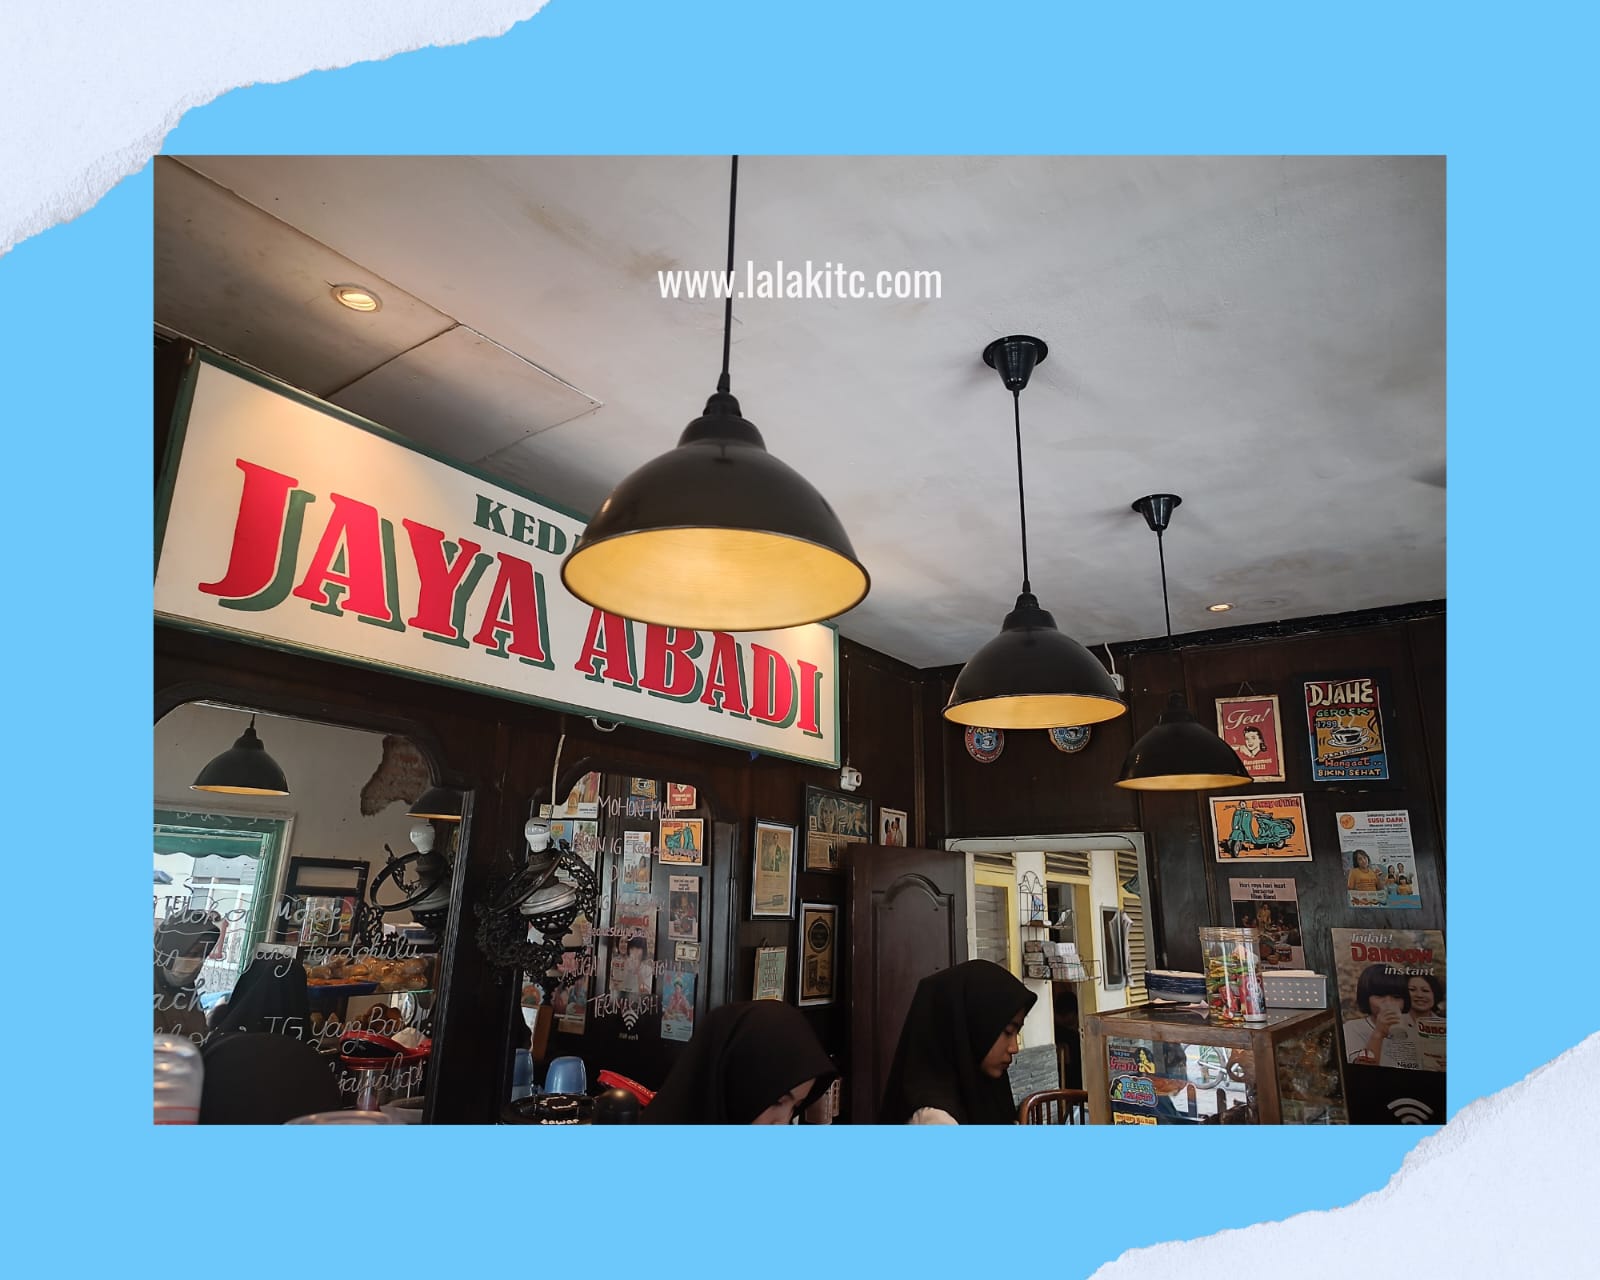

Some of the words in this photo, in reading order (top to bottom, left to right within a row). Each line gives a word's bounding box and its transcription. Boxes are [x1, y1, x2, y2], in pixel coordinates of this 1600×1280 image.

[198, 459, 554, 671] JAYA
[574, 606, 823, 739] ABADI
[1309, 680, 1374, 706] DJAHE
[1225, 708, 1271, 730] Tea!
[1318, 769, 1345, 777] BIKIN
[1349, 768, 1382, 776] SEHAT
[1350, 942, 1433, 963] Dancow
[1384, 965, 1435, 976] instant
